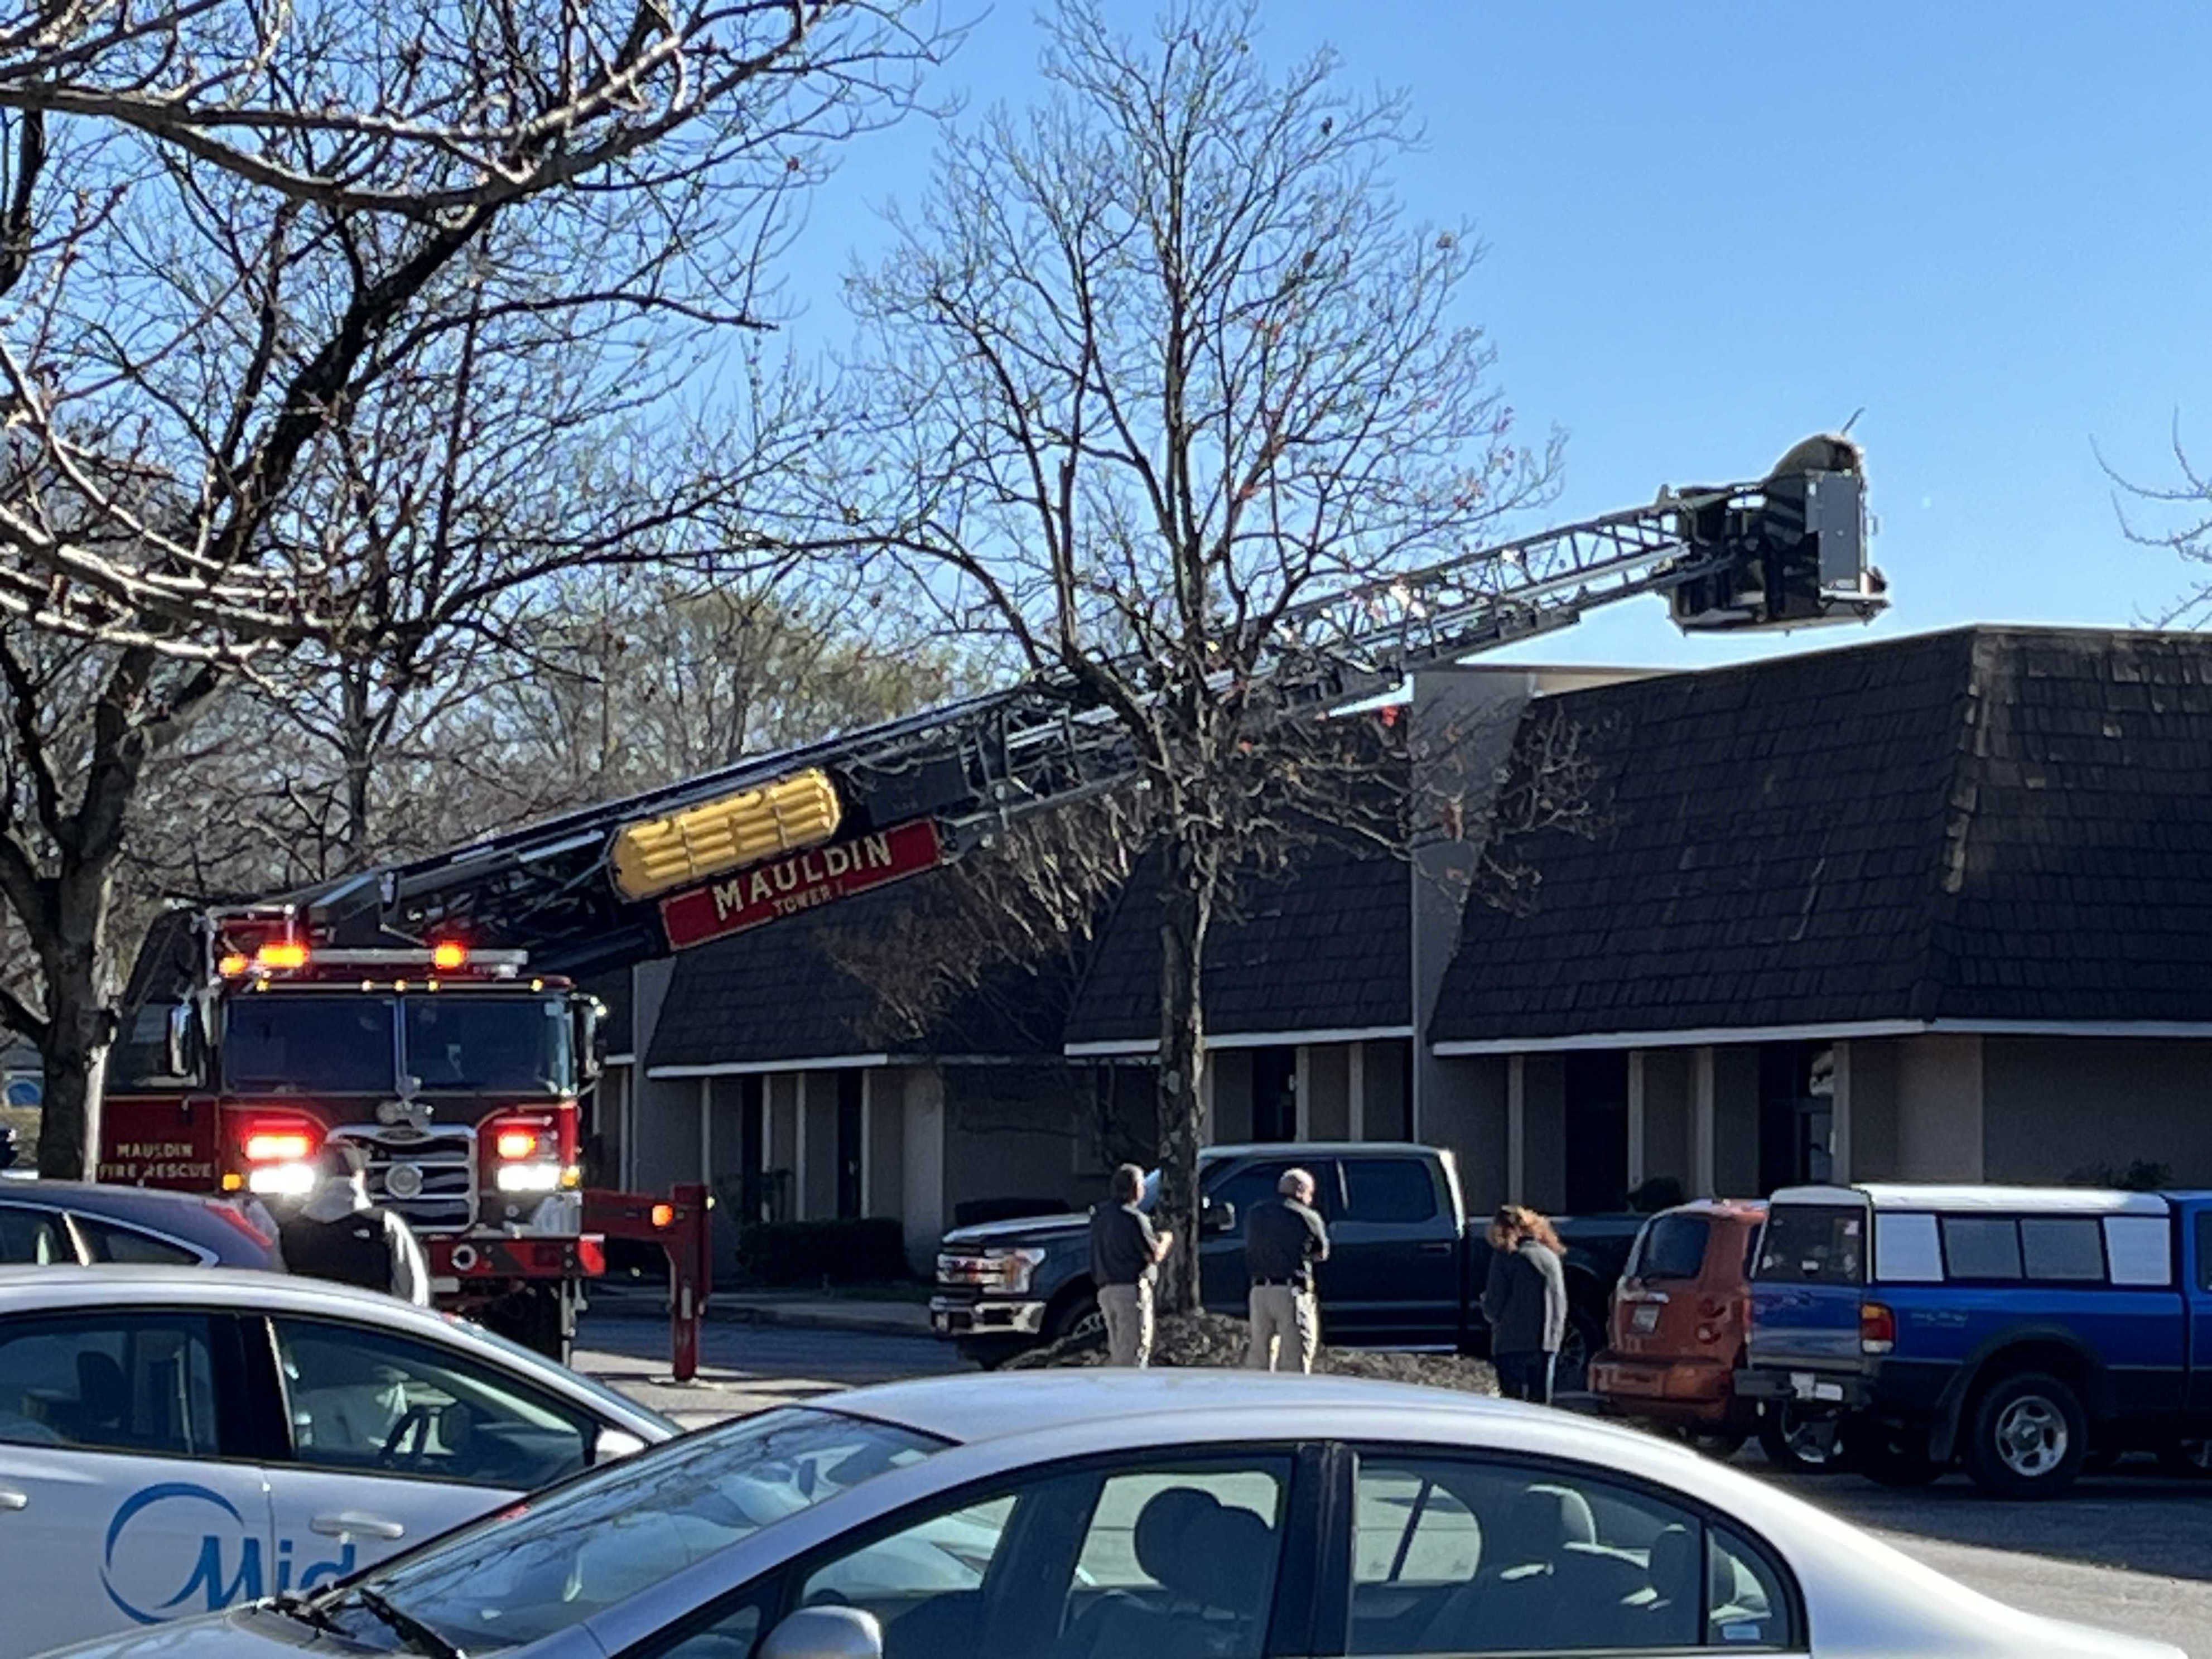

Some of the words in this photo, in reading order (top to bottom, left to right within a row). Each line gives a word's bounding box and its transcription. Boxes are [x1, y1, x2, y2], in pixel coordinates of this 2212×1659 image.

[712, 832, 893, 922] MAULDIN
[116, 1142, 193, 1159] MAULDIN
[143, 1162, 212, 1179] RESCUE
